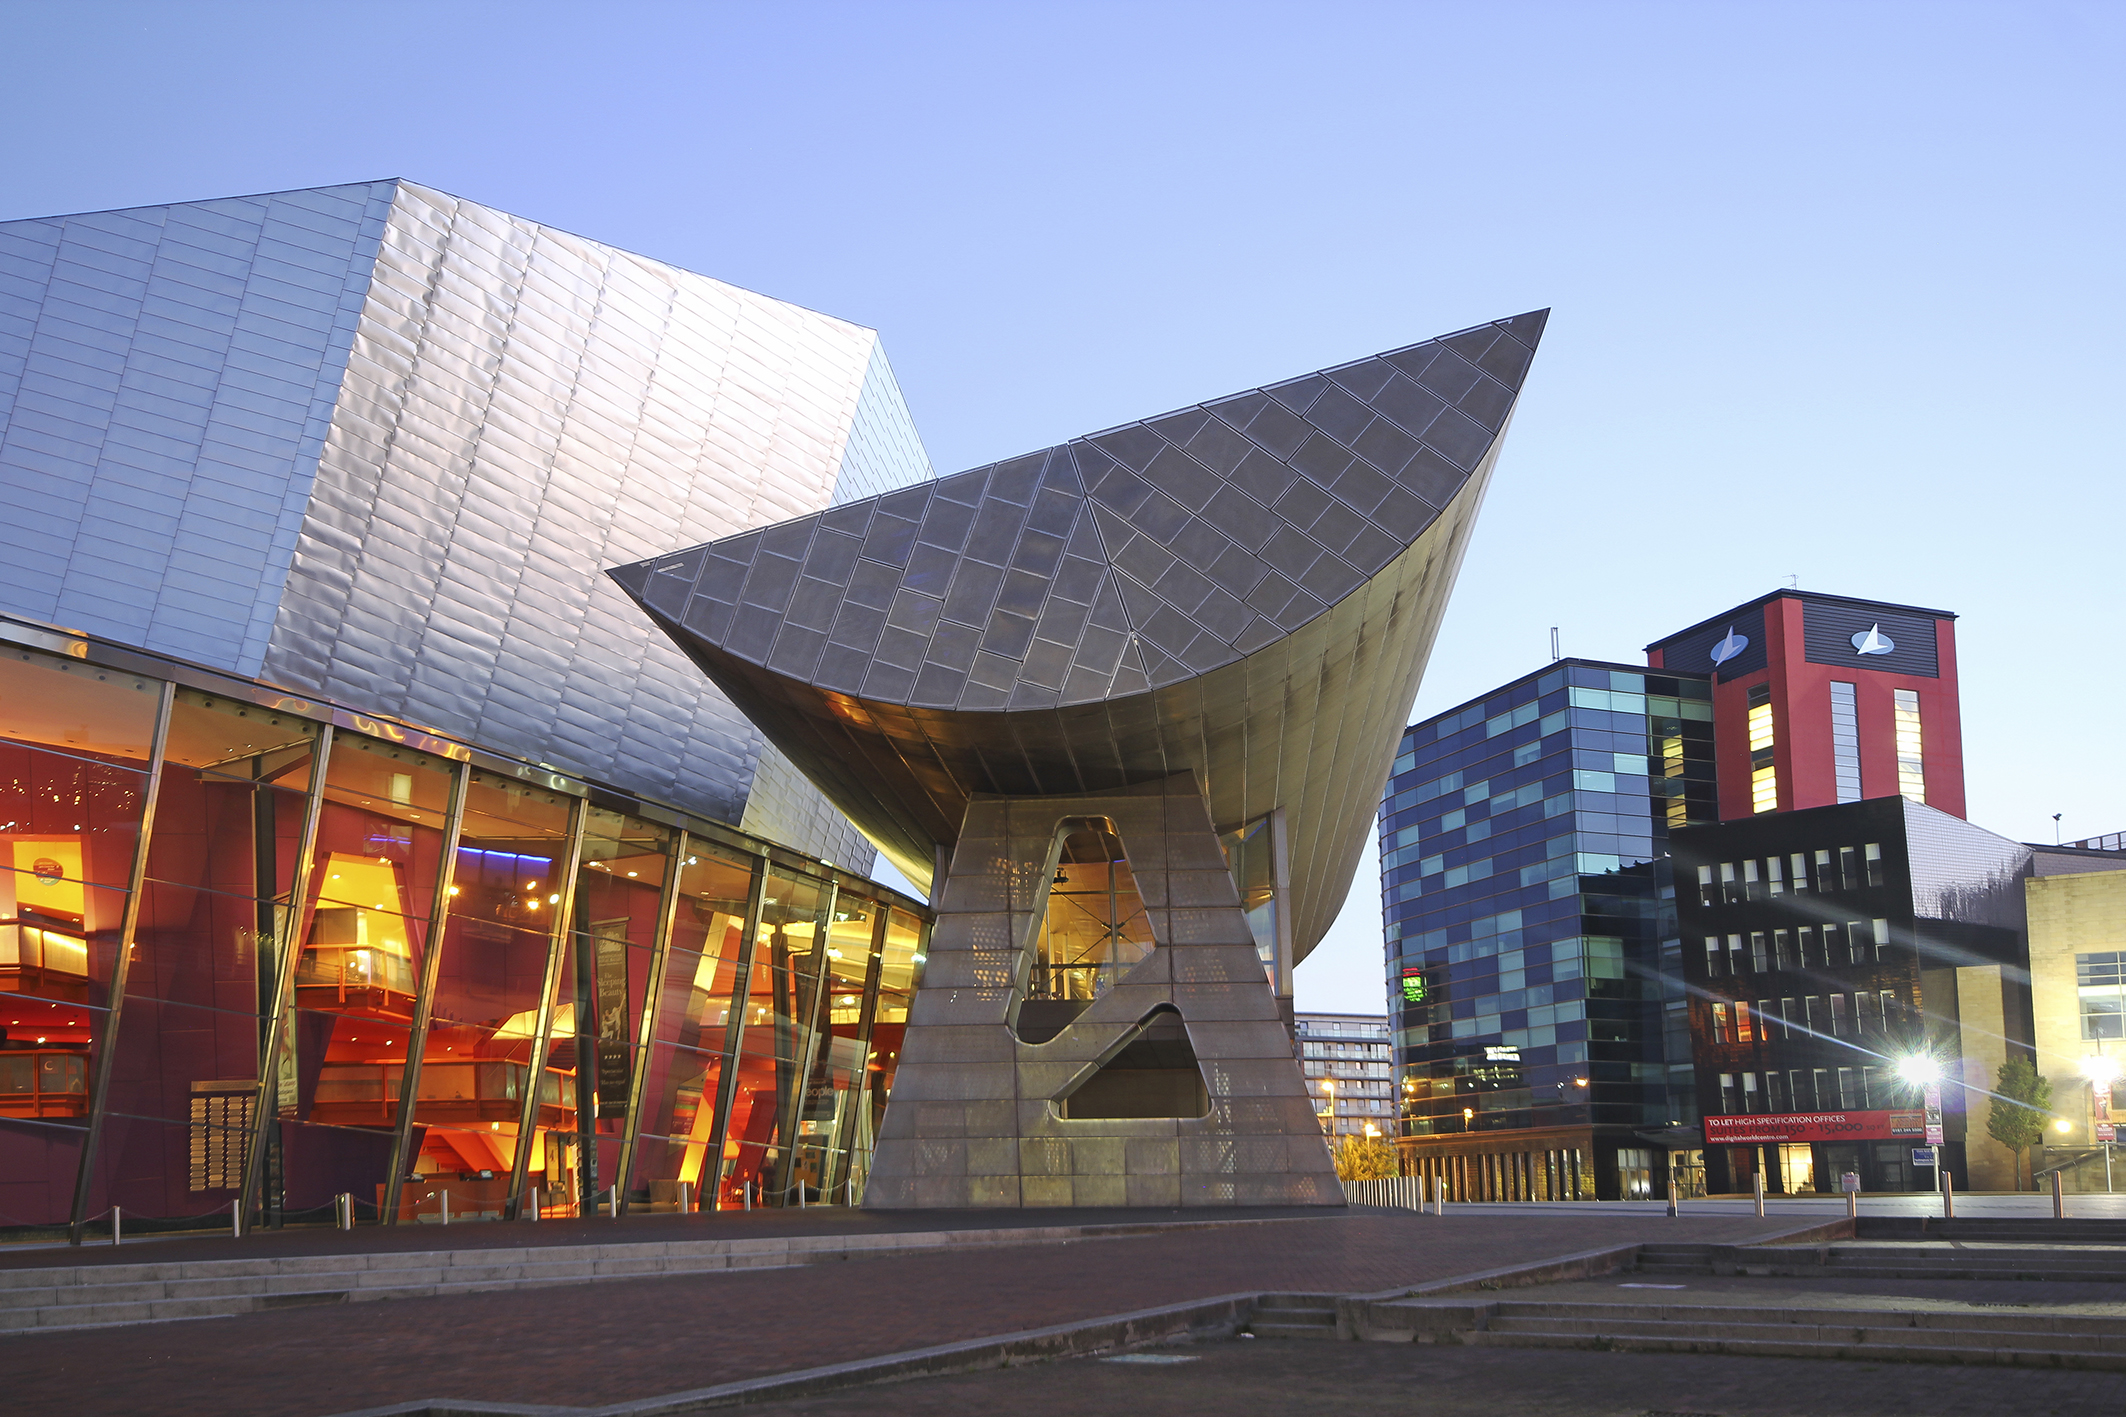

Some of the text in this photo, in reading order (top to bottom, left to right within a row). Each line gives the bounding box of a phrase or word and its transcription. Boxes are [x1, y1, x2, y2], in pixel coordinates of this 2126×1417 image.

[597, 977, 627, 988] Sleeping
[599, 988, 623, 998] Beauty
[805, 1085, 834, 1099] eople
[1708, 1114, 1846, 1127] TO LET HIGH SPECIFICATION OFFICES
[1710, 1126, 1746, 1135] SUITES
[1749, 1124, 1781, 1134] FROM
[1784, 1123, 1806, 1136] 150
[1819, 1122, 1863, 1135] 15,000
